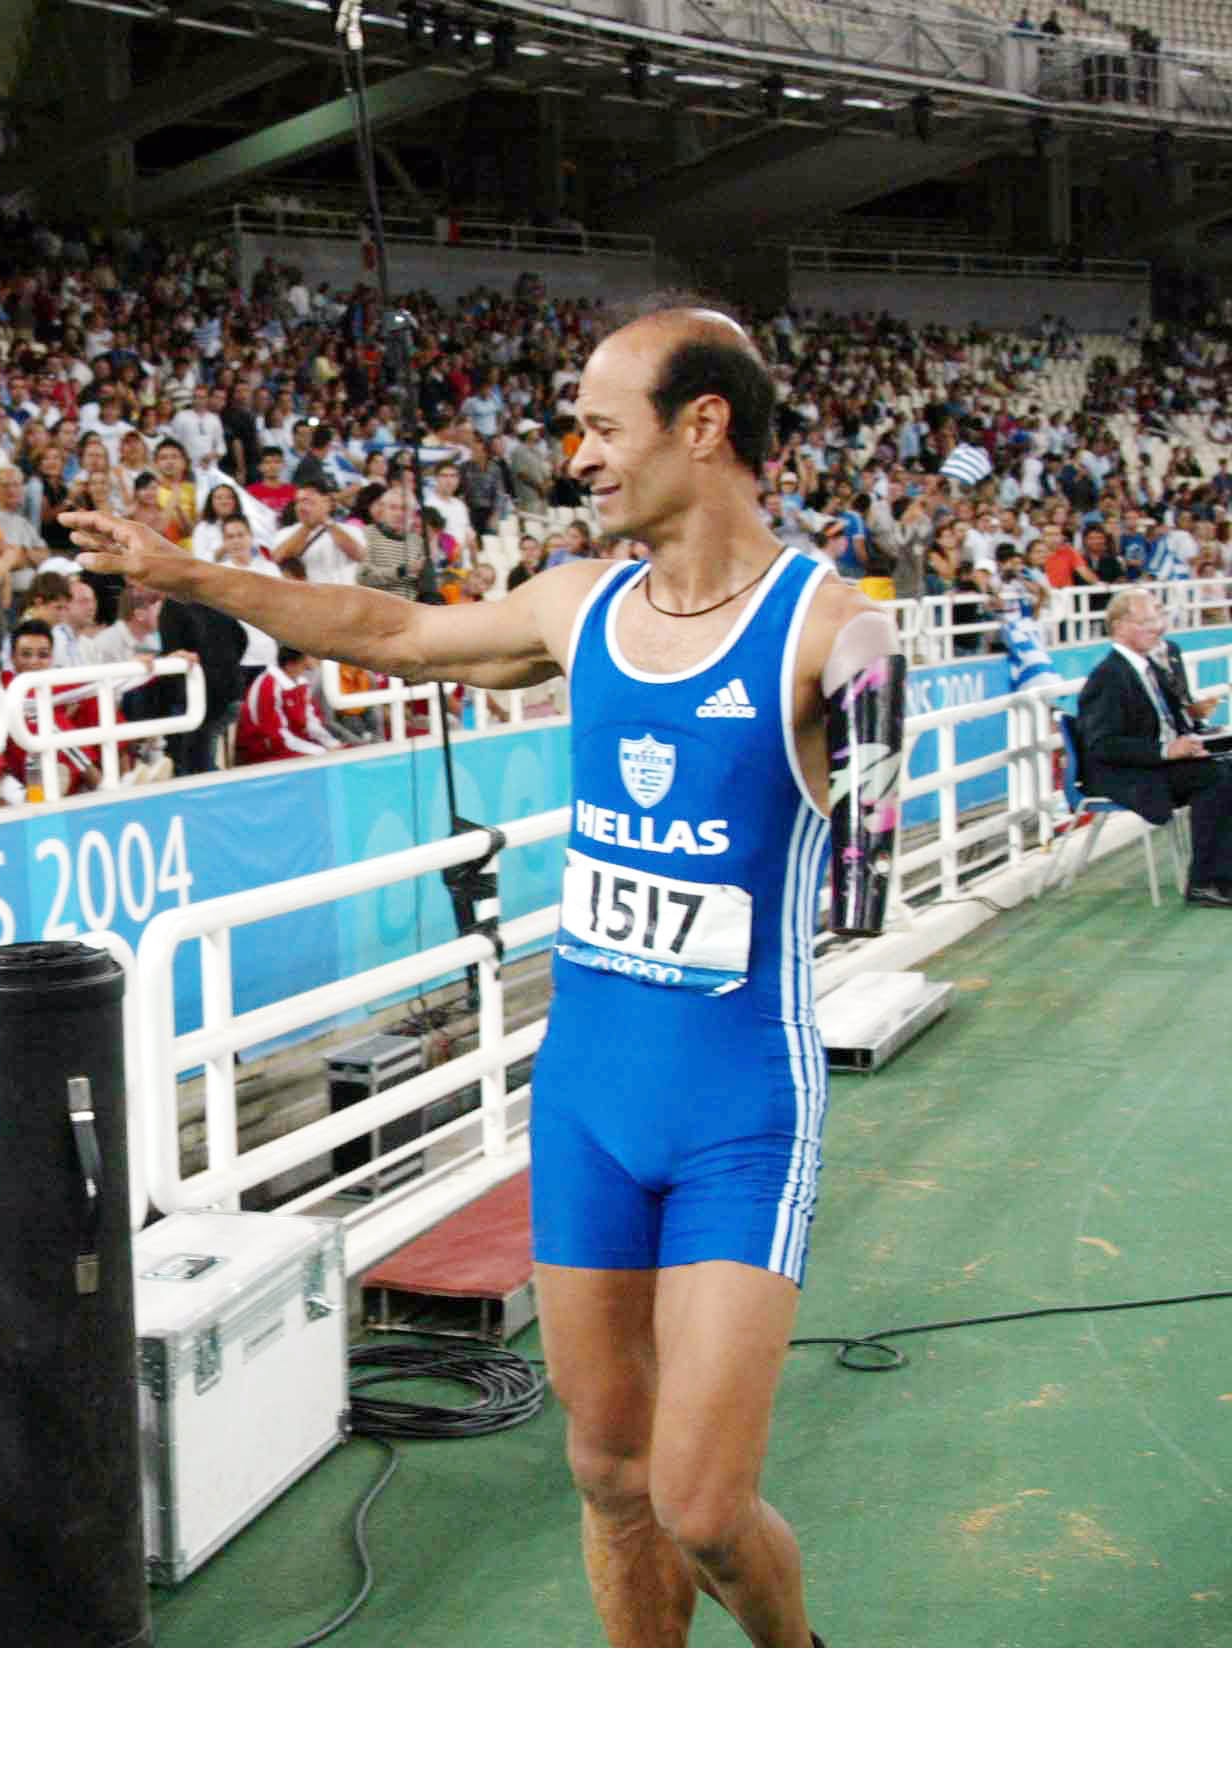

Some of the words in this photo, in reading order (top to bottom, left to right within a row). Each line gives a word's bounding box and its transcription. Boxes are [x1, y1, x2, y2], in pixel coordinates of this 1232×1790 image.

[576, 799, 730, 856] HELLAS
[35, 815, 194, 939] 2004
[589, 870, 705, 955] 1517
